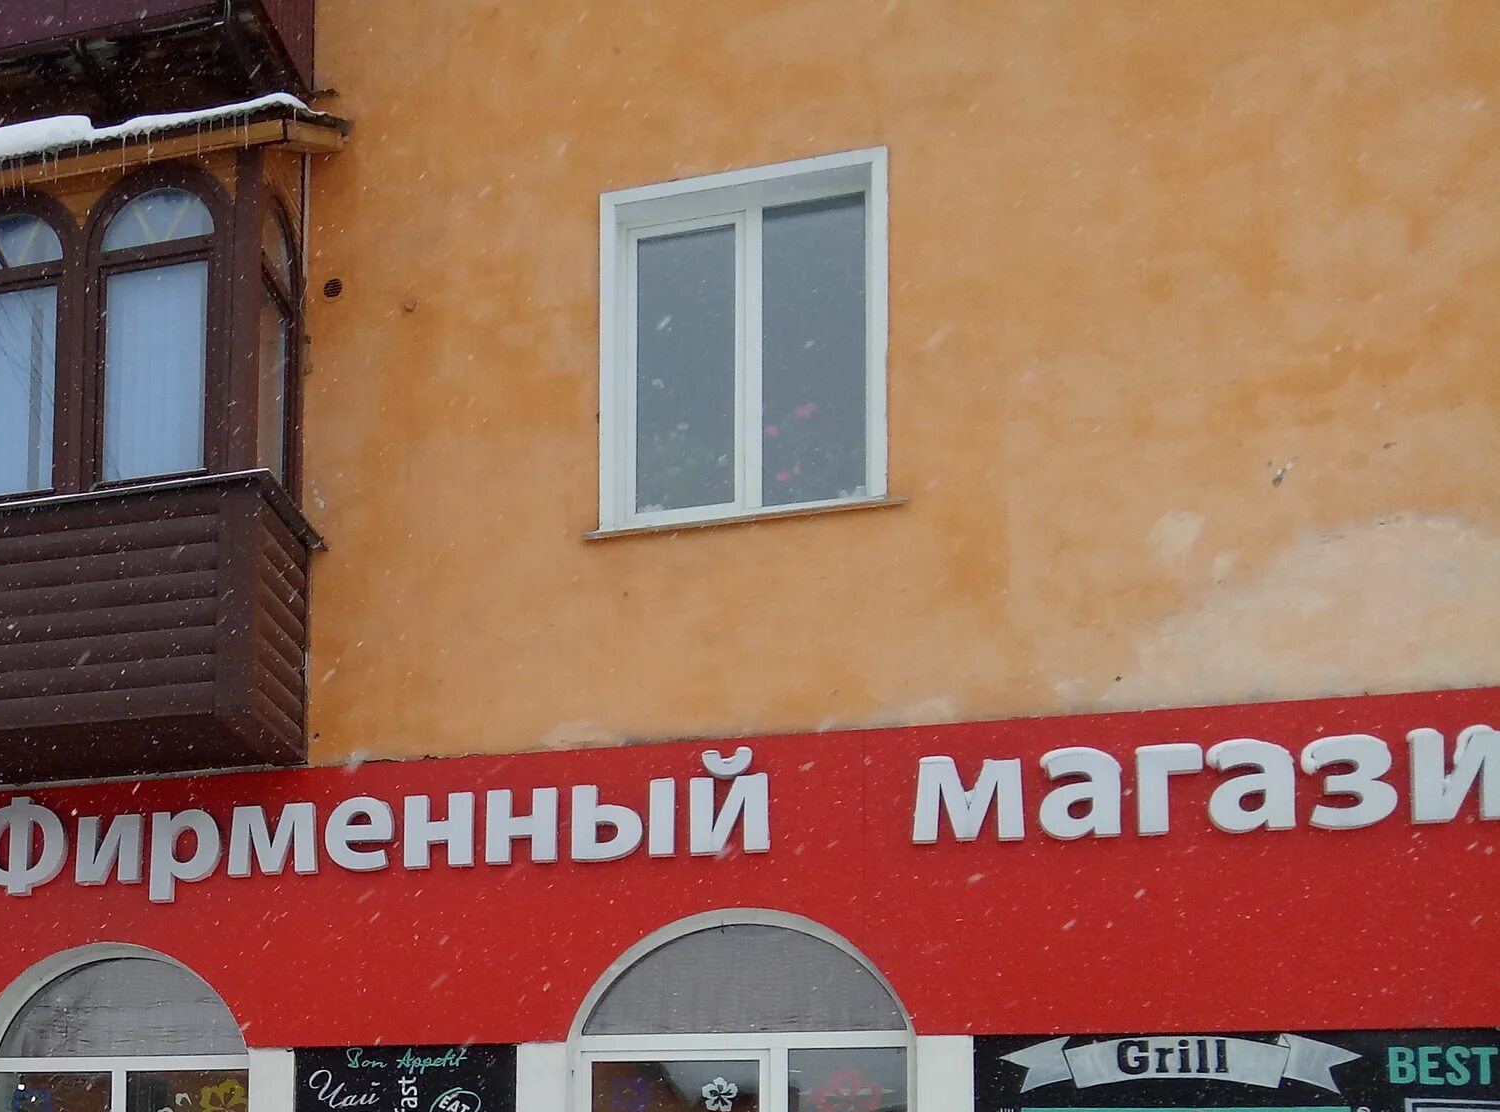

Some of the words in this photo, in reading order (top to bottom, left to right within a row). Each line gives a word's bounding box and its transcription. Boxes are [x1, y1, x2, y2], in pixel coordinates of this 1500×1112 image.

[346, 1048, 388, 1069] Bon
[1116, 1039, 1230, 1075] Grill
[1388, 1046, 1498, 1086] BEST
[308, 1069, 381, 1109] Чай
